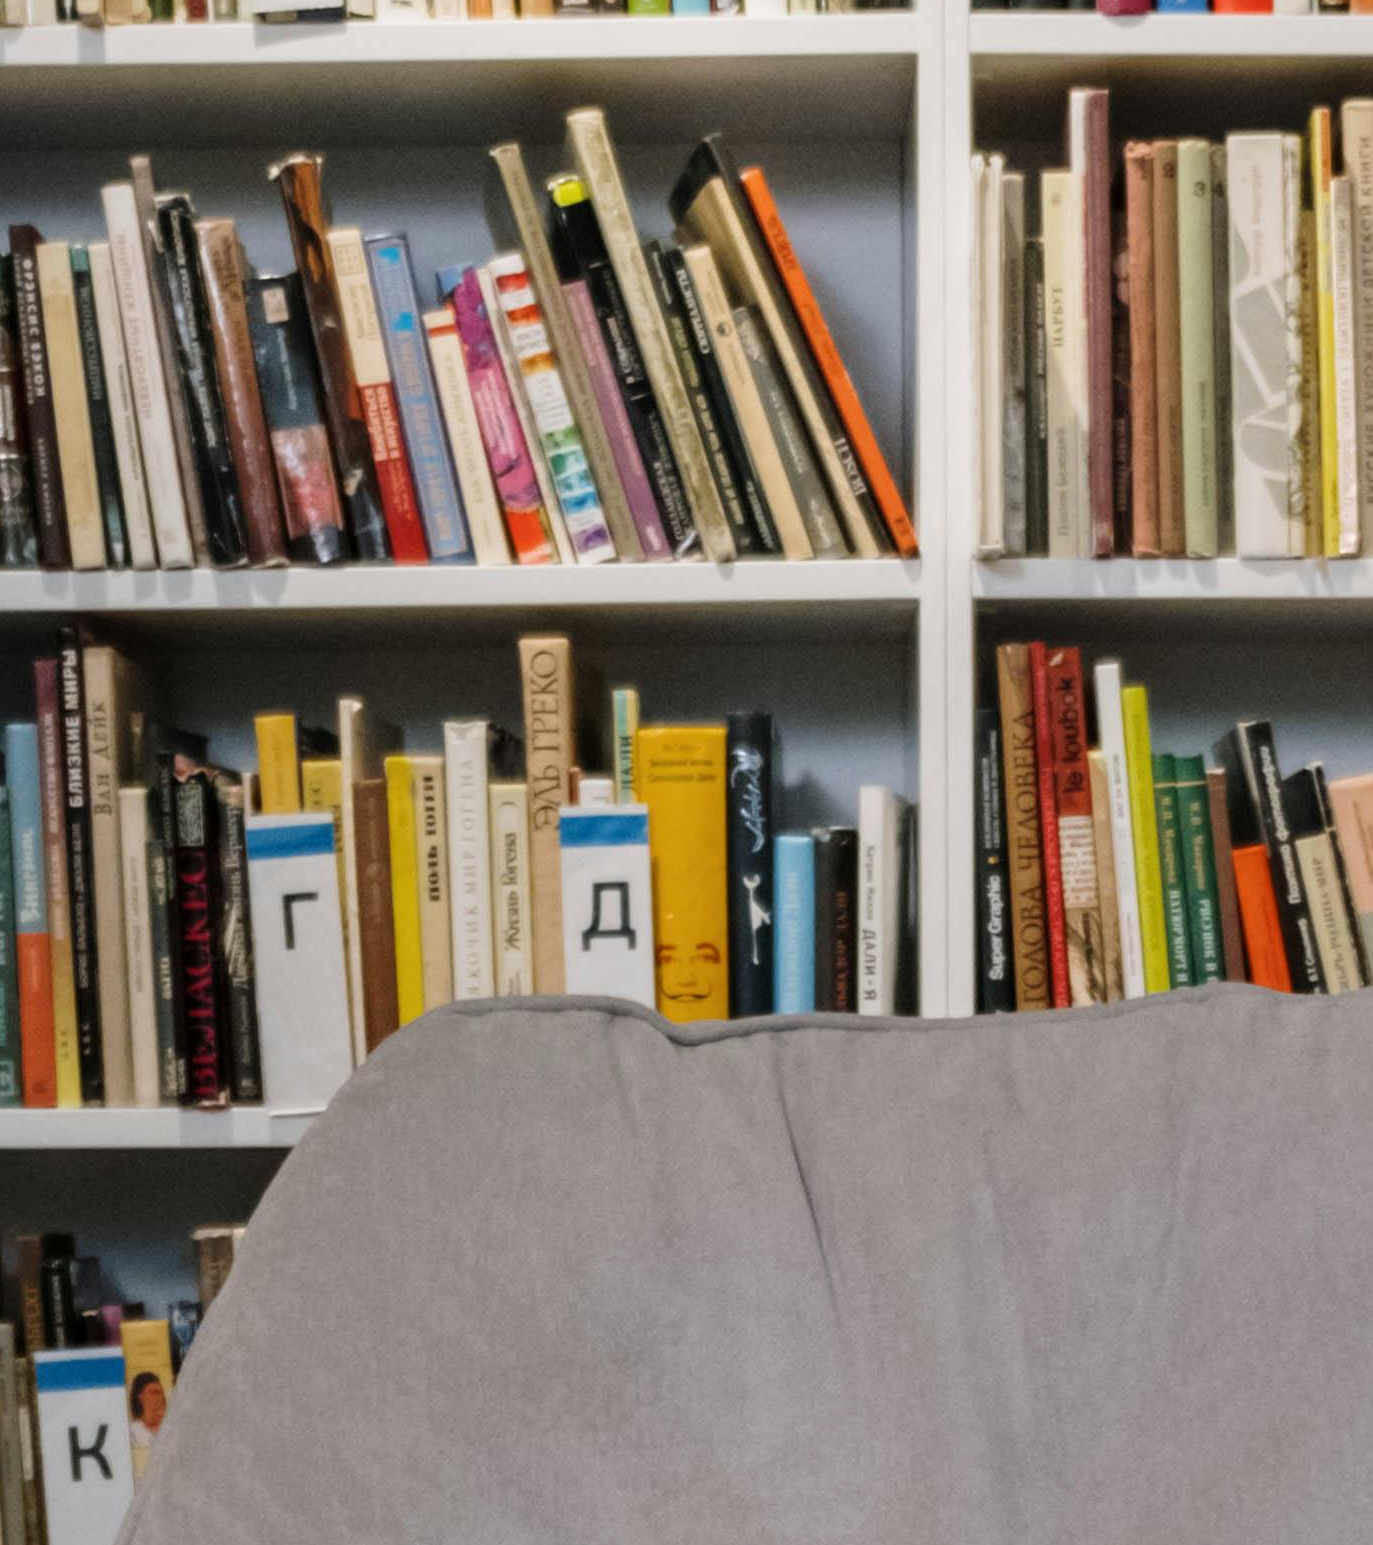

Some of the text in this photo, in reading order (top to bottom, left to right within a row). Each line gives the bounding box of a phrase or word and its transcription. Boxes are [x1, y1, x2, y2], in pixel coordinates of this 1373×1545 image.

[1050, 286, 1066, 348] НАРБУТ
[60, 649, 84, 808] БЛИЗКИЕ МИРЫ
[532, 650, 560, 833] ЭЛЬ ГРЕКО
[1055, 675, 1081, 765] loubok
[1013, 709, 1042, 1005] ГОЛОВА ЧЕЛОВЕКА
[282, 892, 317, 949] Г
[580, 881, 635, 951] Д
[67, 1424, 114, 1484] К
